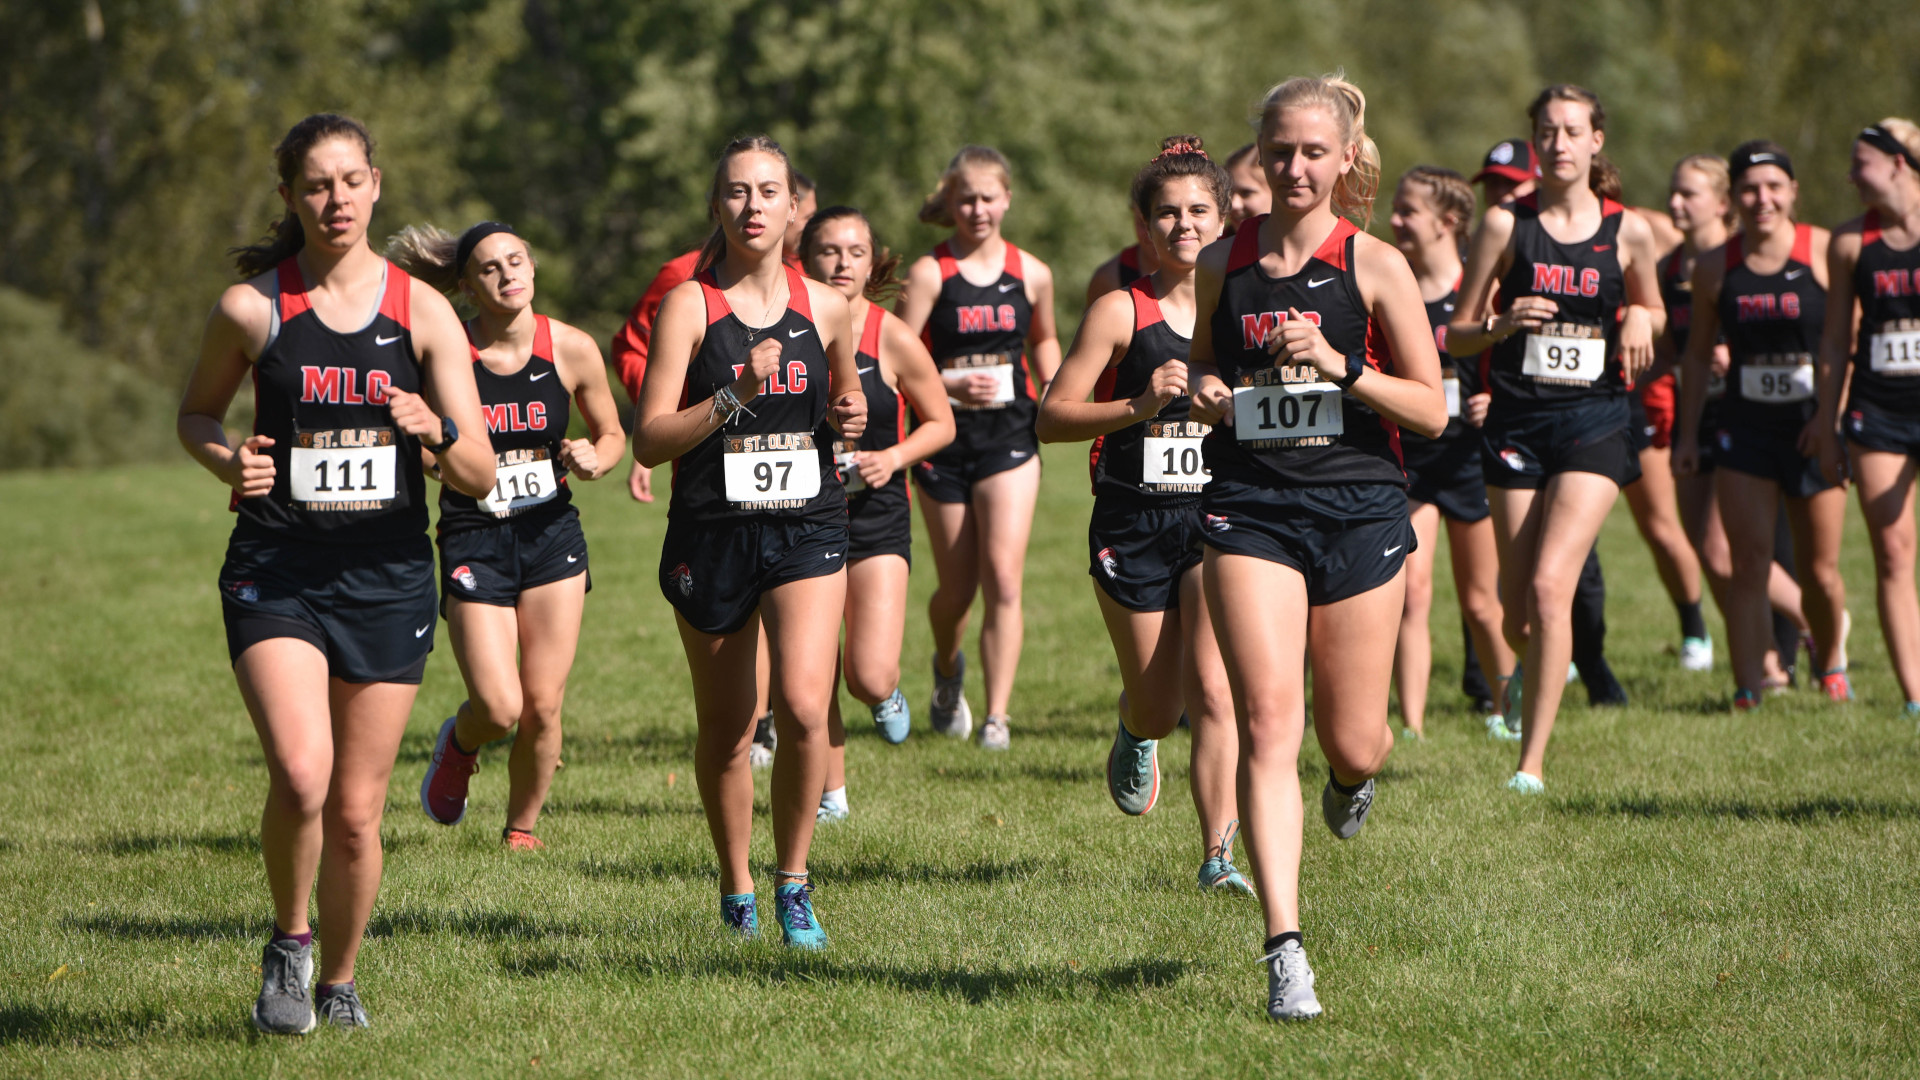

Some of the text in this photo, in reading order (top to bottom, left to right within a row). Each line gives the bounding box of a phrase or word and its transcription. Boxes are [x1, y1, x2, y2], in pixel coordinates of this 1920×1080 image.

[1532, 262, 1600, 298] MLC
[956, 304, 1016, 333] MLC
[1736, 292, 1800, 322] MLC
[1547, 346, 1580, 371] 93
[301, 366, 391, 405] MLC
[1254, 366, 1319, 387] ST. OLAF
[1761, 373, 1792, 396] 95
[482, 401, 547, 434] MLC
[1257, 394, 1322, 430] 107
[313, 429, 378, 449] ST. OLAF
[1163, 421, 1213, 438] ST. OLA
[1252, 436, 1331, 449] INVITATIONAL
[505, 448, 534, 465] OLAF
[744, 434, 800, 453] ST. OLAF
[315, 458, 377, 492] 111
[1162, 447, 1212, 476] 10
[494, 471, 541, 503] 116
[753, 461, 793, 493] 97
[1156, 483, 1203, 493] INVITATIO
[306, 500, 383, 512] INVITATIONAL
